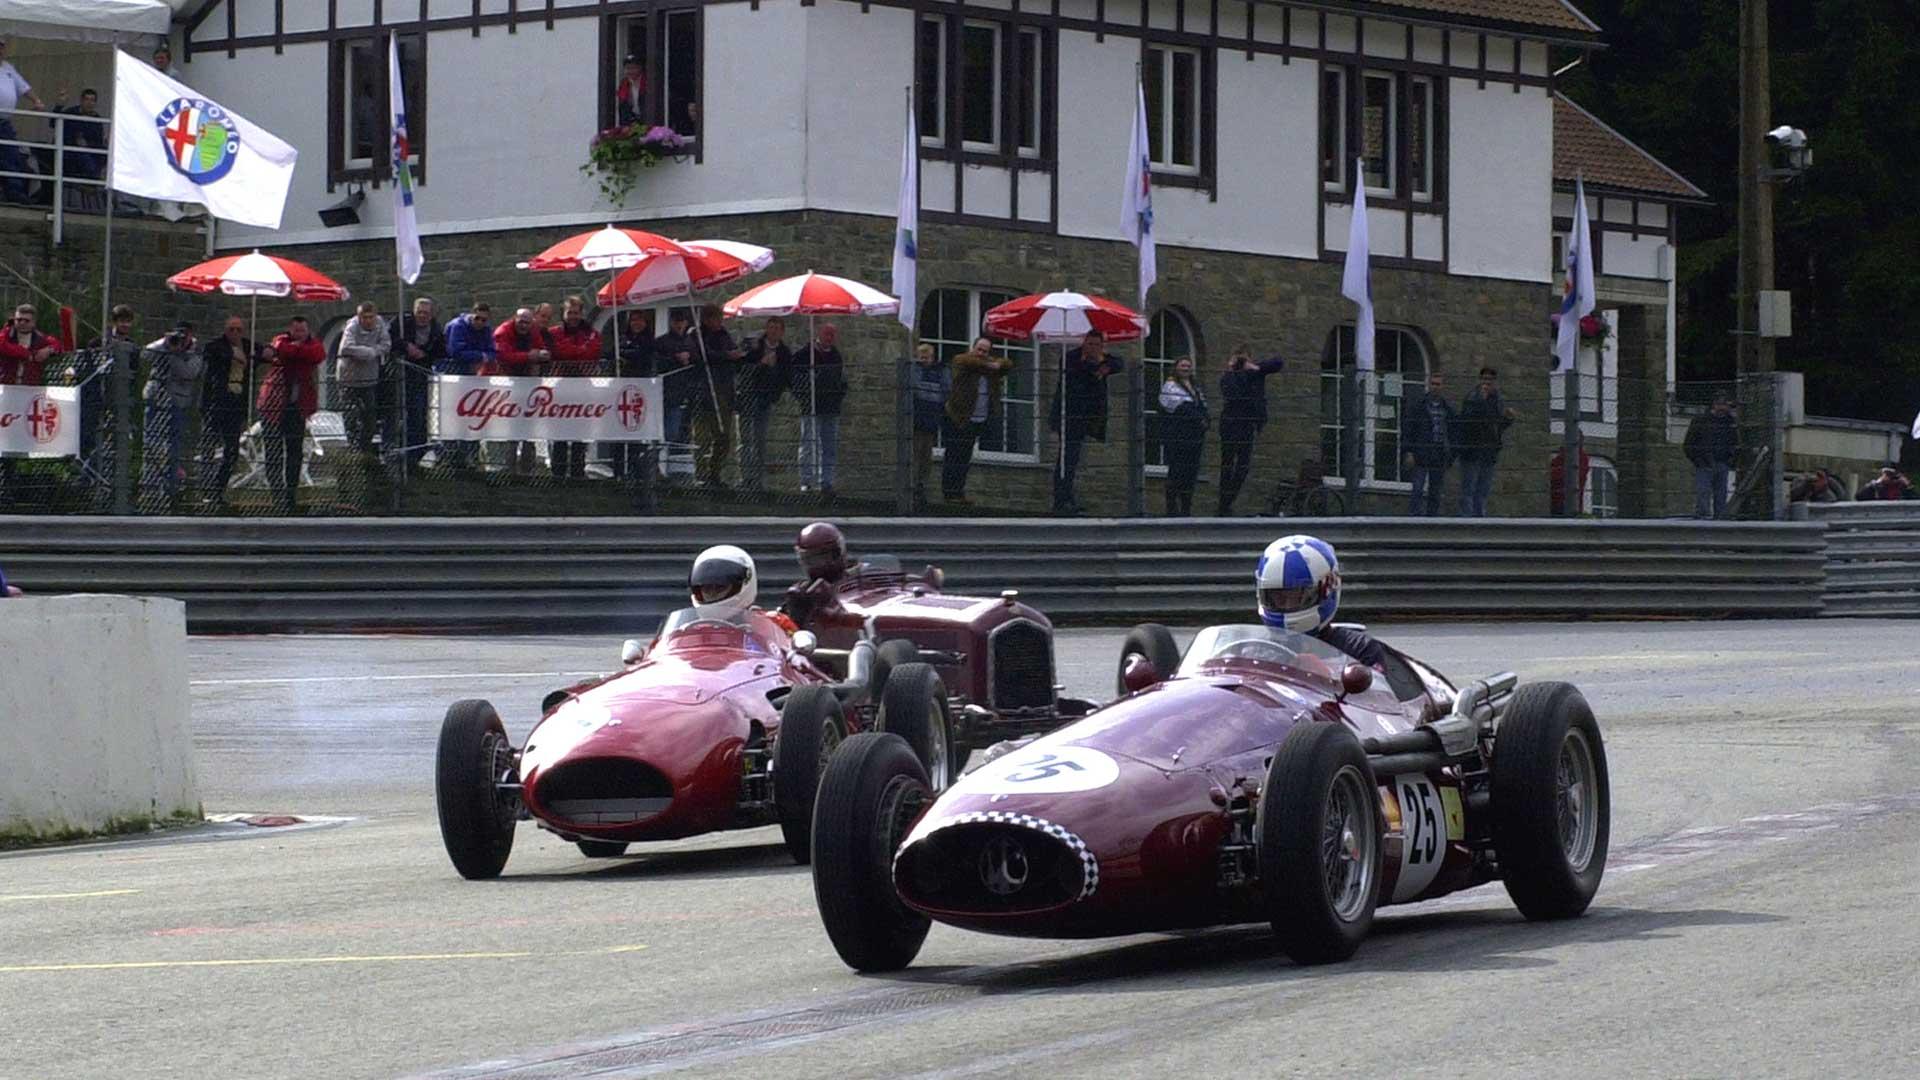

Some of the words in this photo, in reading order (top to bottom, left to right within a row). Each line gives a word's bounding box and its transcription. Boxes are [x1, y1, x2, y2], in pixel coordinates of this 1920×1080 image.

[456, 388, 521, 431] Alfa
[524, 386, 612, 418] Romeo
[1403, 783, 1437, 864] 25
